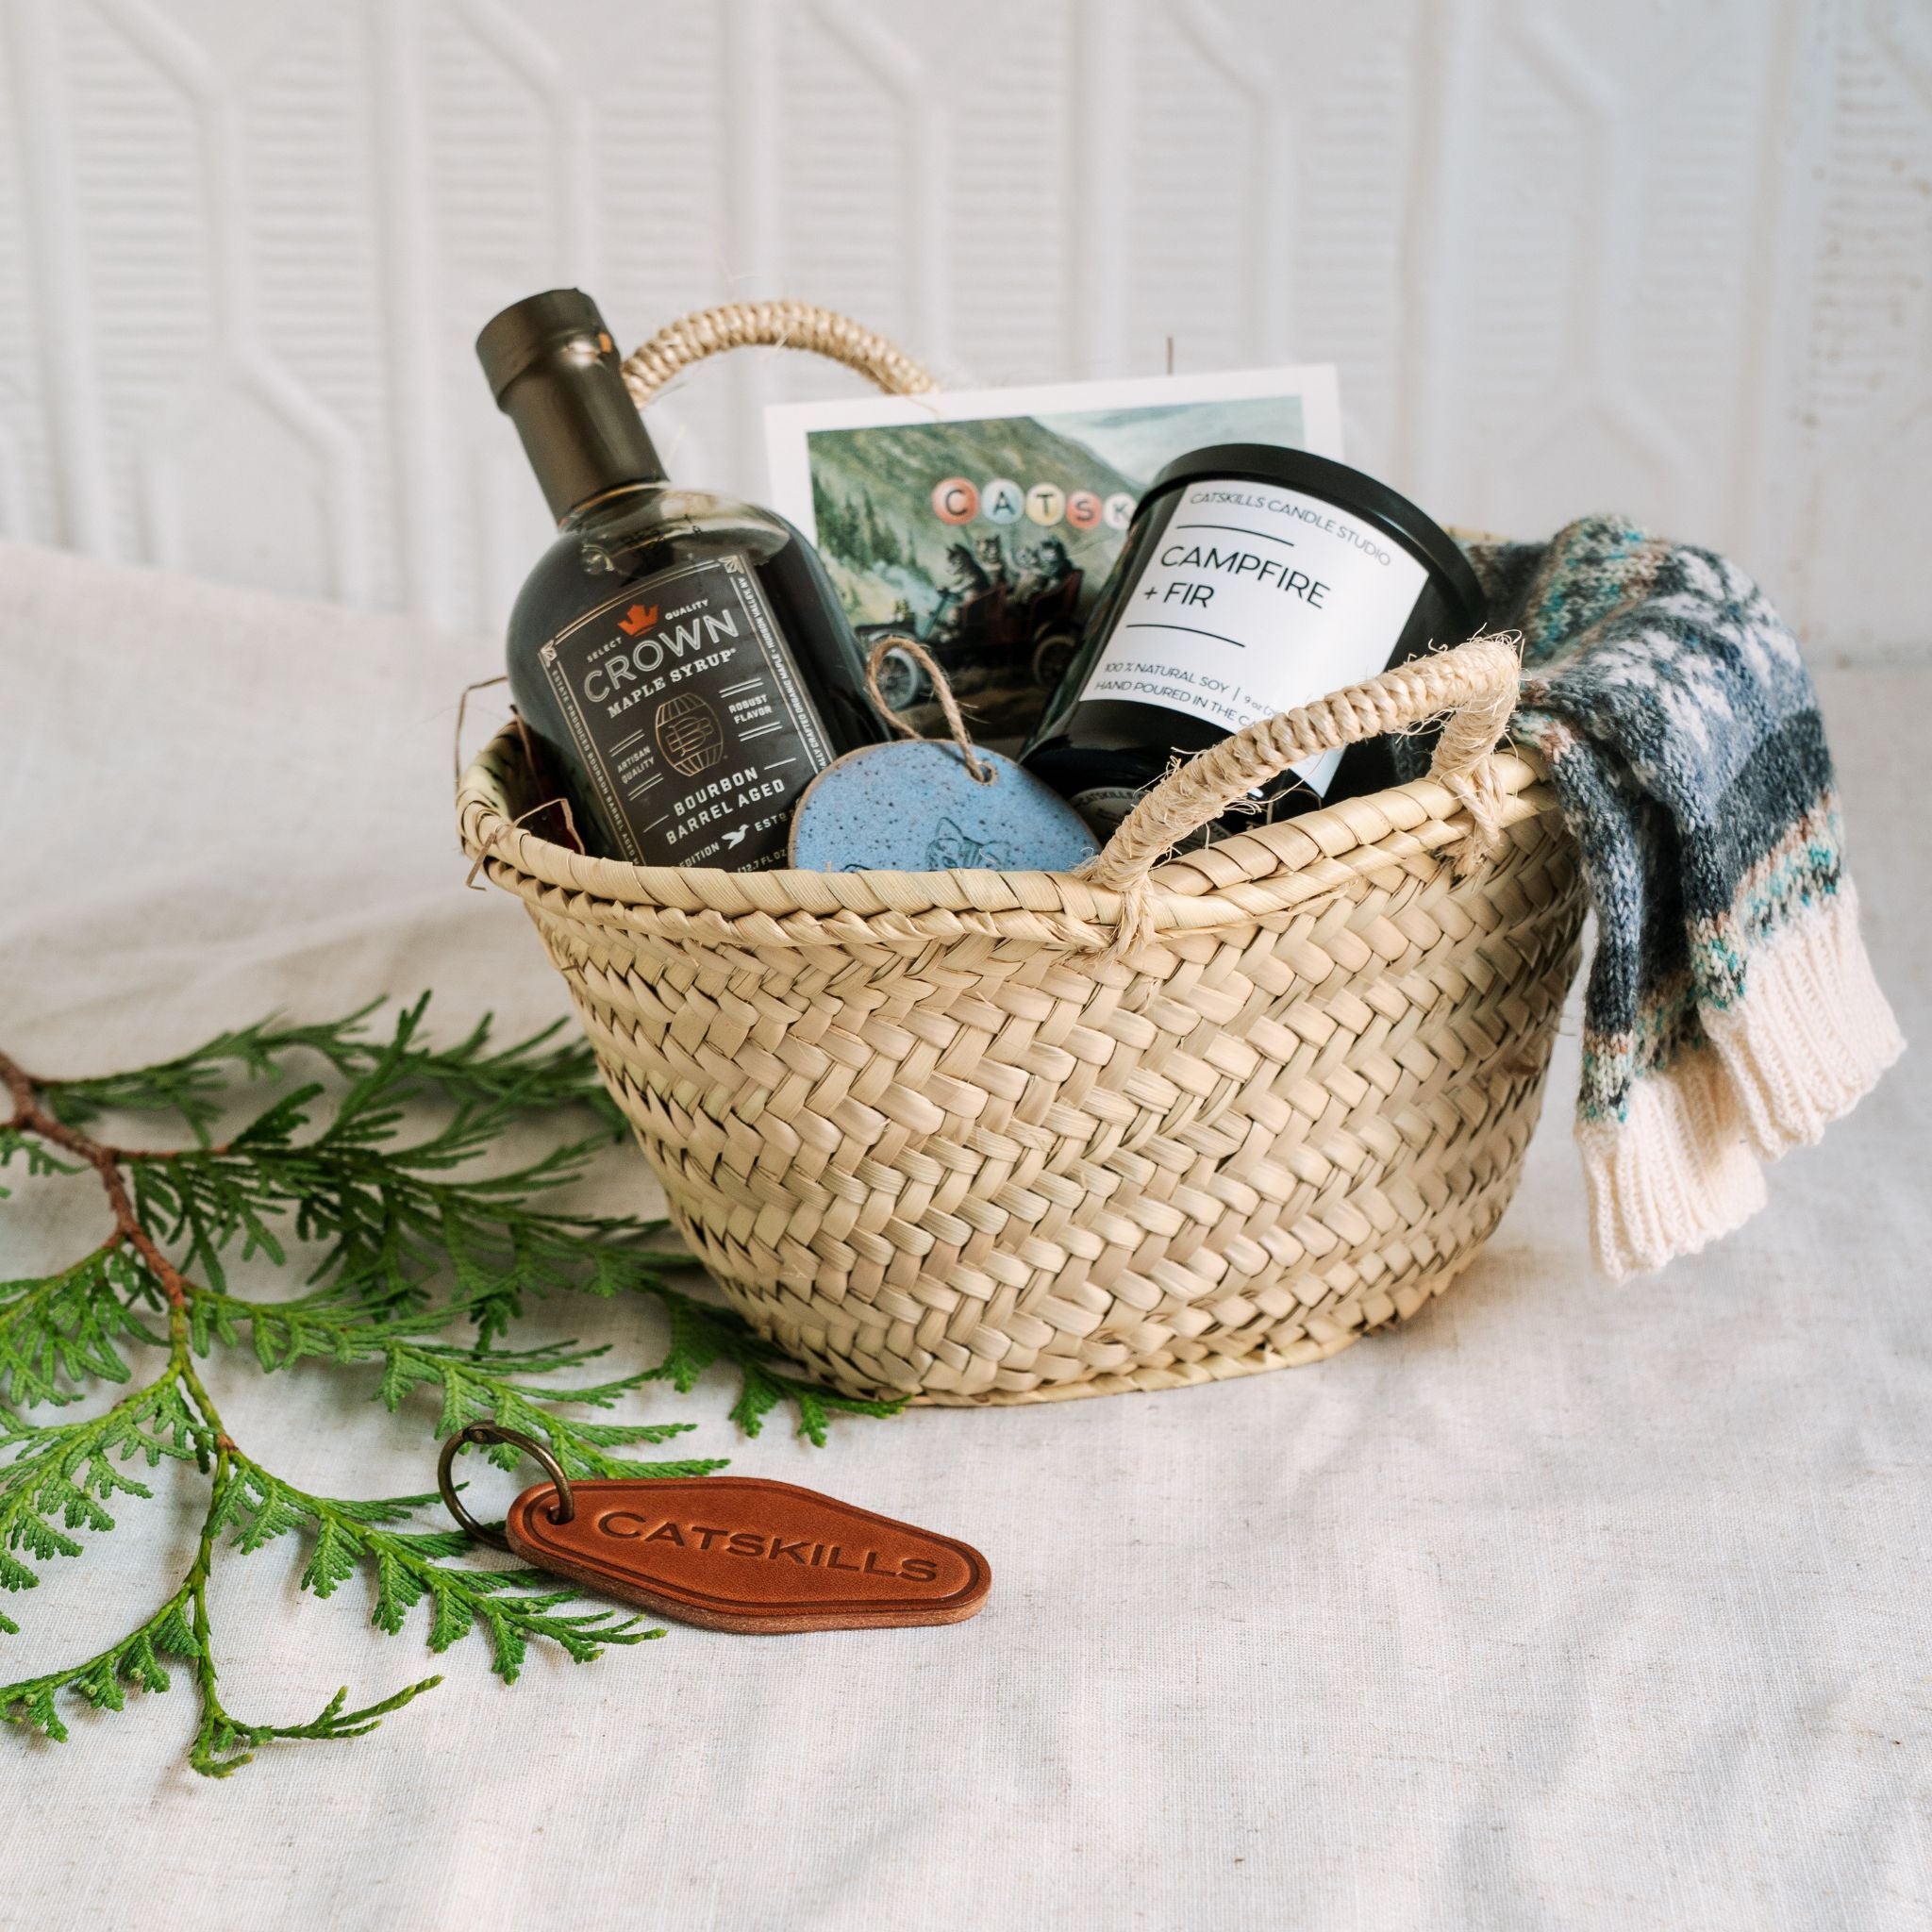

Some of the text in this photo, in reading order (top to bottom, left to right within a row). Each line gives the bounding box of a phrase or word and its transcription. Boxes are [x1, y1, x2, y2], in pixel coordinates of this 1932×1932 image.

[1190, 491, 1391, 567] CATSKILLS CANDLE STUDIO
[1160, 545, 1331, 609] CAMPFIRE
[664, 598, 708, 621] QUALITY
[1163, 582, 1215, 608] FIR
[583, 608, 740, 703] CROWN
[586, 636, 624, 663] SELECT
[1134, 662, 1196, 684] NATURAL
[1198, 675, 1230, 694] SOY
[607, 675, 666, 719] MAPLE
[728, 693, 769, 714] ROBUST
[1094, 680, 1133, 691] HAND
[1133, 681, 1191, 703] POURED
[1192, 695, 1209, 710] IN
[1210, 701, 1238, 722] THE
[733, 705, 773, 724] FLAVOR
[616, 745, 651, 774] ARTISAN
[620, 757, 656, 784] QUALITY
[673, 766, 758, 817] BOURBON
[665, 778, 786, 845] BARREL AGED
[760, 855, 774, 866] FL
[596, 1510, 941, 1585] CATSKILLS
